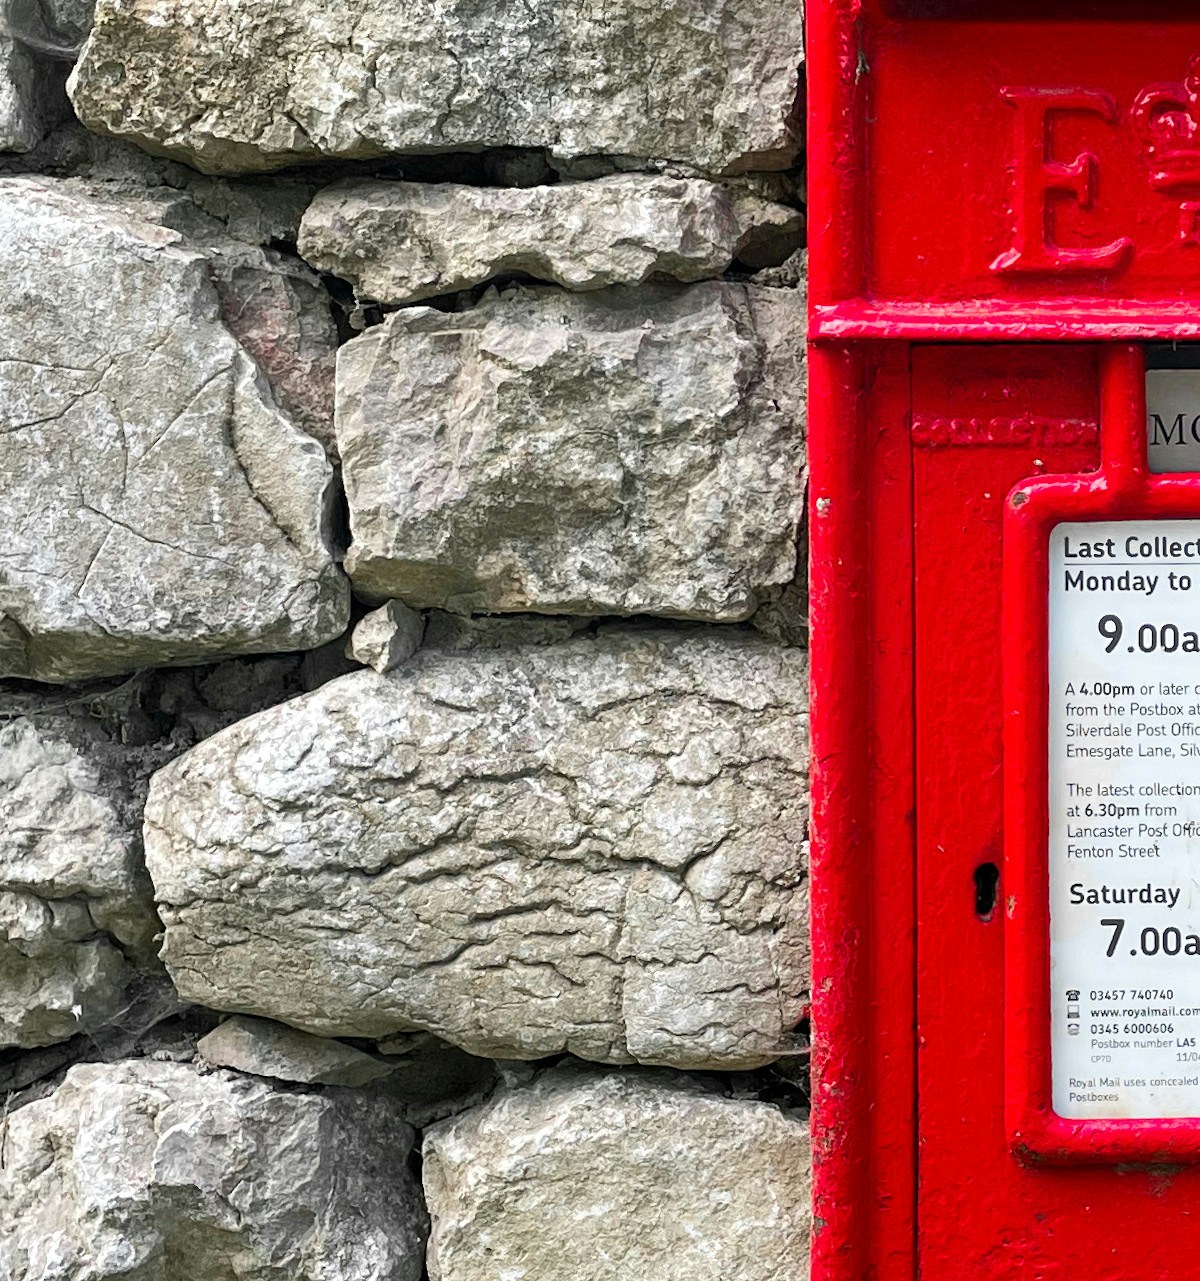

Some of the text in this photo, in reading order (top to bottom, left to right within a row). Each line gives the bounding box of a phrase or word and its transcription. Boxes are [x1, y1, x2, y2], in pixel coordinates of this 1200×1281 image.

[1064, 536, 1116, 558] Last
[1065, 570, 1158, 595] Monday
[1168, 572, 1191, 590] to
[1065, 683, 1075, 695] A
[1080, 683, 1134, 698] 4.00pm
[1140, 686, 1154, 695] or
[1159, 682, 1190, 695] later
[1066, 703, 1098, 716] from
[1104, 703, 1125, 716] the
[1131, 703, 1183, 715] Postbox
[1066, 723, 1131, 737] Silverdale
[1137, 723, 1166, 736] Post
[1067, 744, 1133, 760] Emesgate
[1139, 744, 1175, 758] Lane,
[1066, 783, 1092, 796] The
[1098, 783, 1134, 796] latest
[1139, 783, 1200, 796] collection
[1067, 803, 1176, 819] at 6.30pm from
[1067, 825, 1133, 838] Lancaster
[1139, 823, 1168, 837] Post
[1068, 844, 1160, 858] Fenton Street
[1070, 884, 1180, 908] Saturday
[1090, 990, 1173, 1000] 03457 740740
[1091, 1024, 1173, 1034] 0345 6000606
[1091, 1039, 1130, 1049] Postbox
[1134, 1038, 1173, 1048] number
[1069, 1078, 1096, 1089] Royal
[1100, 1078, 1120, 1087] Mail
[1124, 1079, 1146, 1087] uses
[1150, 1076, 1198, 1086] concealed
[1069, 1092, 1118, 1102] Postboxes
